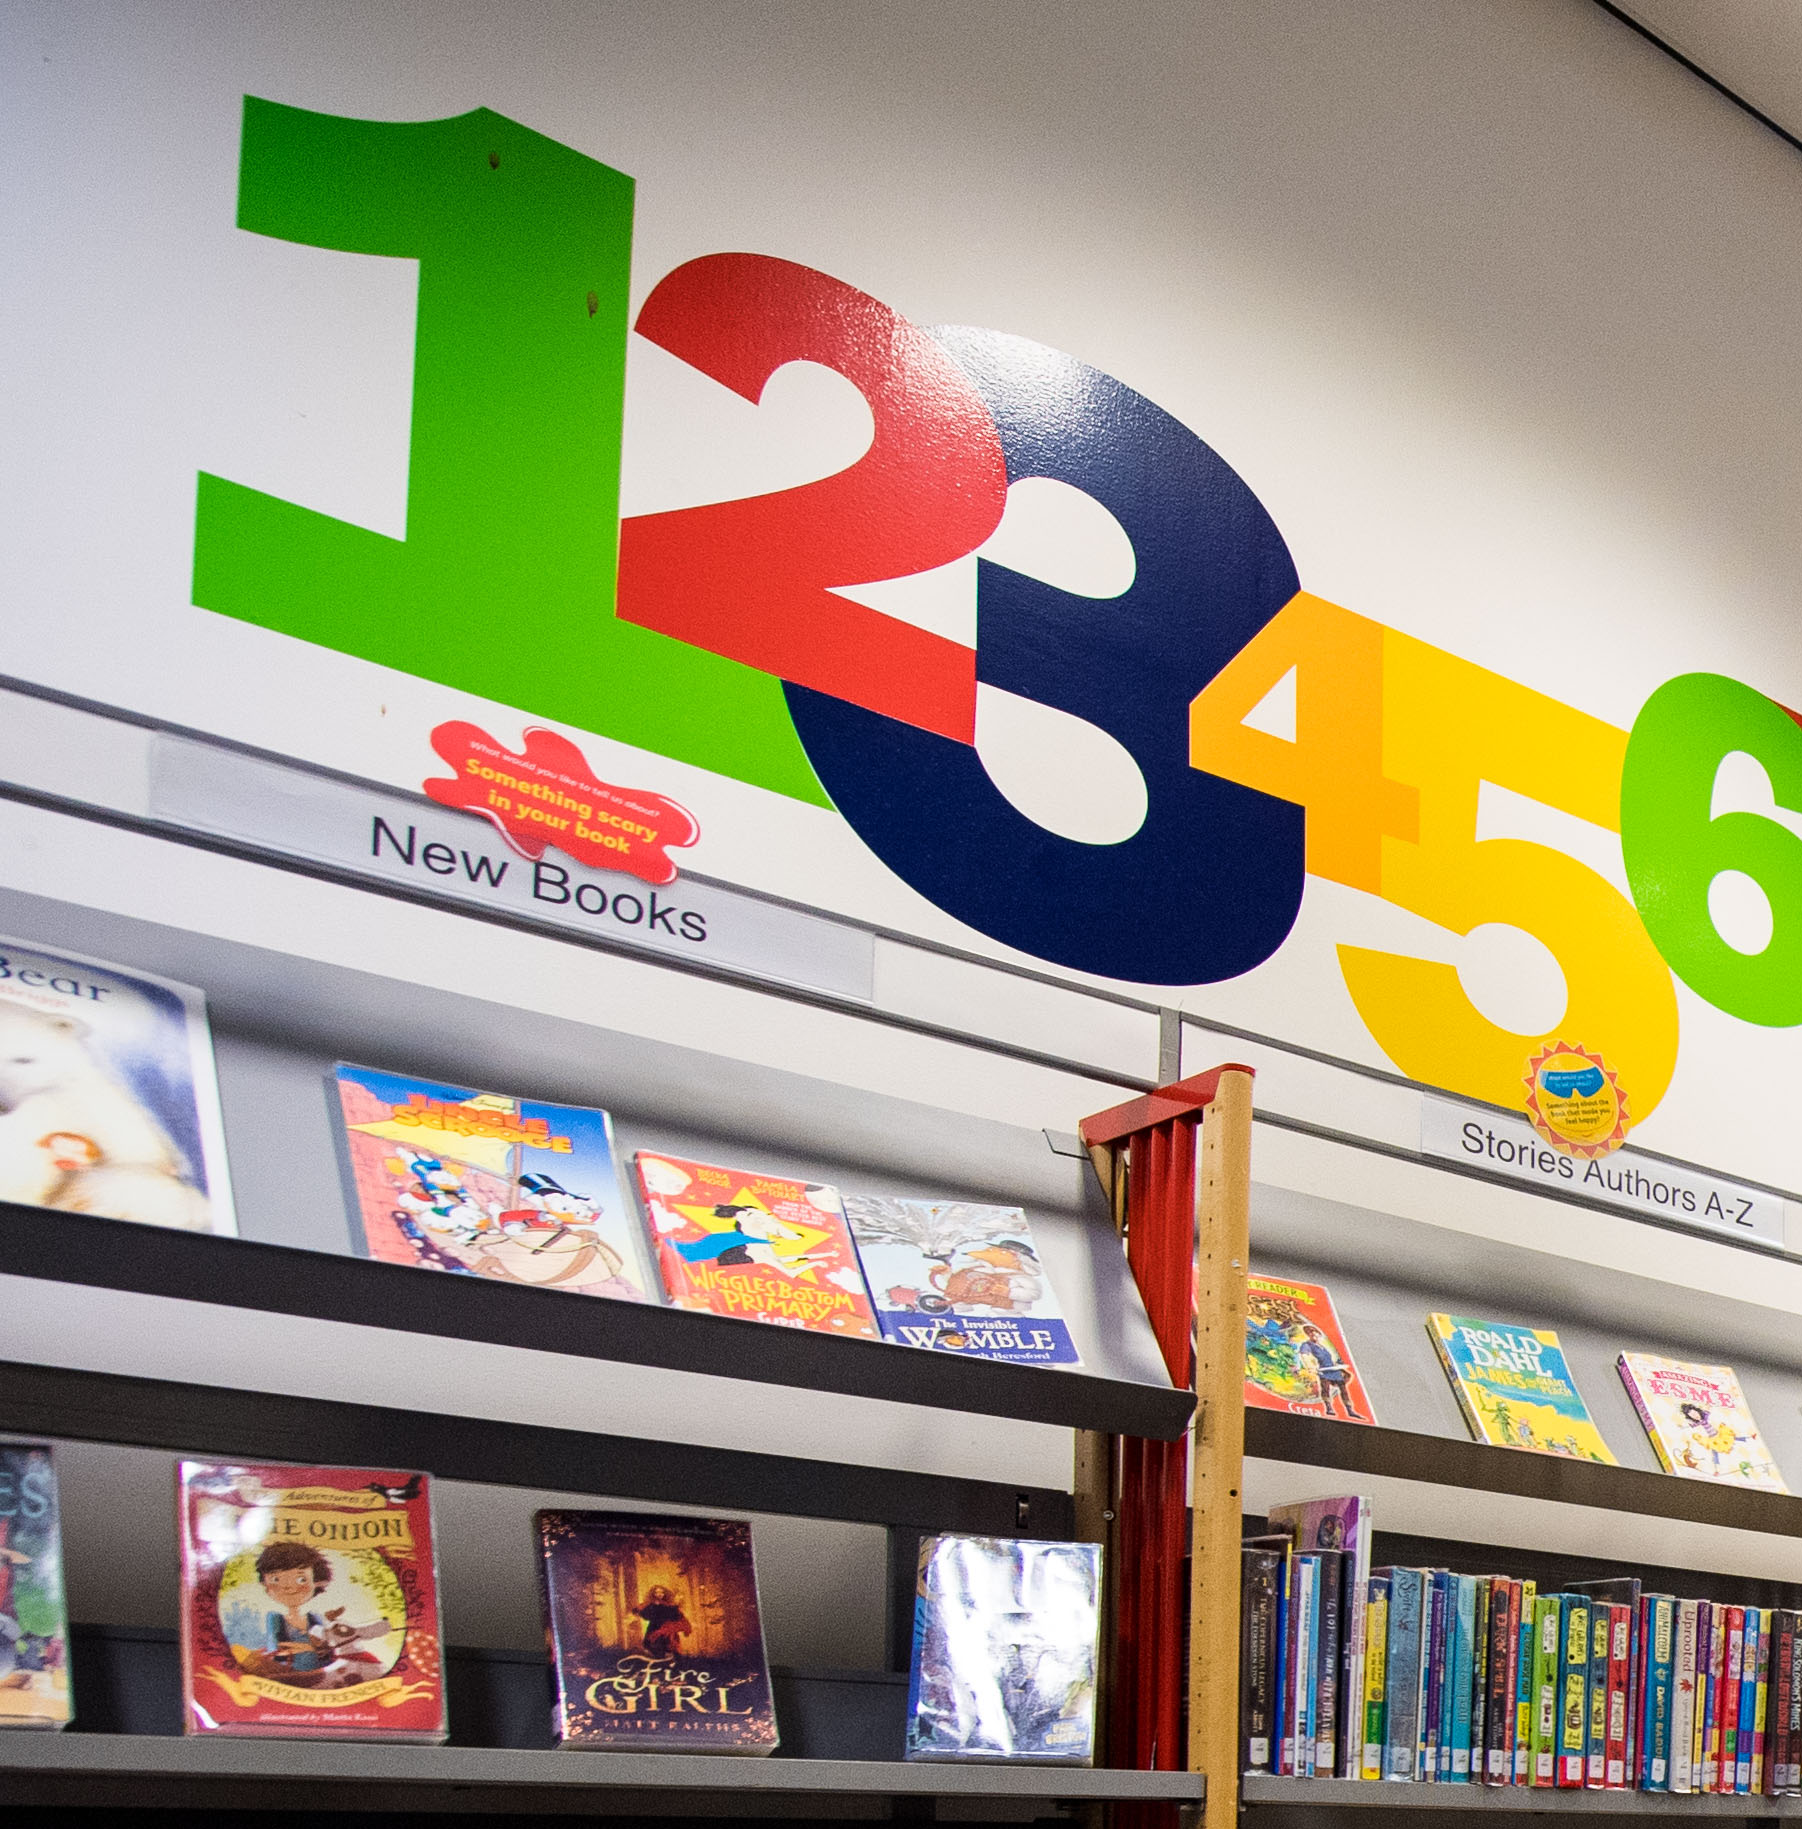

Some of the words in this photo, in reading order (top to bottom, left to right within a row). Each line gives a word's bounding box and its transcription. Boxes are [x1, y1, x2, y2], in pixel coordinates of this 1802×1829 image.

[191, 93, 836, 812] 1
[617, 251, 1007, 747] 2
[779, 323, 1305, 988] 3
[1189, 589, 1420, 895] 4
[466, 758, 592, 820] Something
[598, 811, 658, 842] scary
[502, 754, 535, 771] would
[537, 764, 557, 780] you
[559, 771, 576, 787] like
[592, 783, 609, 798] tell
[487, 789, 513, 810] in
[516, 801, 569, 831] your
[575, 819, 630, 854] book
[371, 816, 510, 888] New
[532, 861, 707, 942] Books
[1336, 627, 1682, 1130] 5
[392, 1104, 574, 1154] SCROOGE
[1462, 1122, 1573, 1179] Stories
[1583, 1160, 1696, 1211] Authors
[1704, 1191, 1754, 1227] A-Z
[719, 1289, 832, 1321] PRIMARY
[930, 1318, 957, 1330] The
[962, 1318, 1019, 1331] Invisible
[1459, 1326, 1543, 1356] ROALD
[1469, 1343, 1552, 1378] DAHL
[1647, 1379, 1736, 1409] ESME
[1658, 1371, 1709, 1389] AMAZING
[311, 1519, 409, 1541] ONION
[1682, 1611, 1694, 1672] Uprooted
[585, 1677, 753, 1714] GIRL
[617, 1655, 717, 1693] Fire
